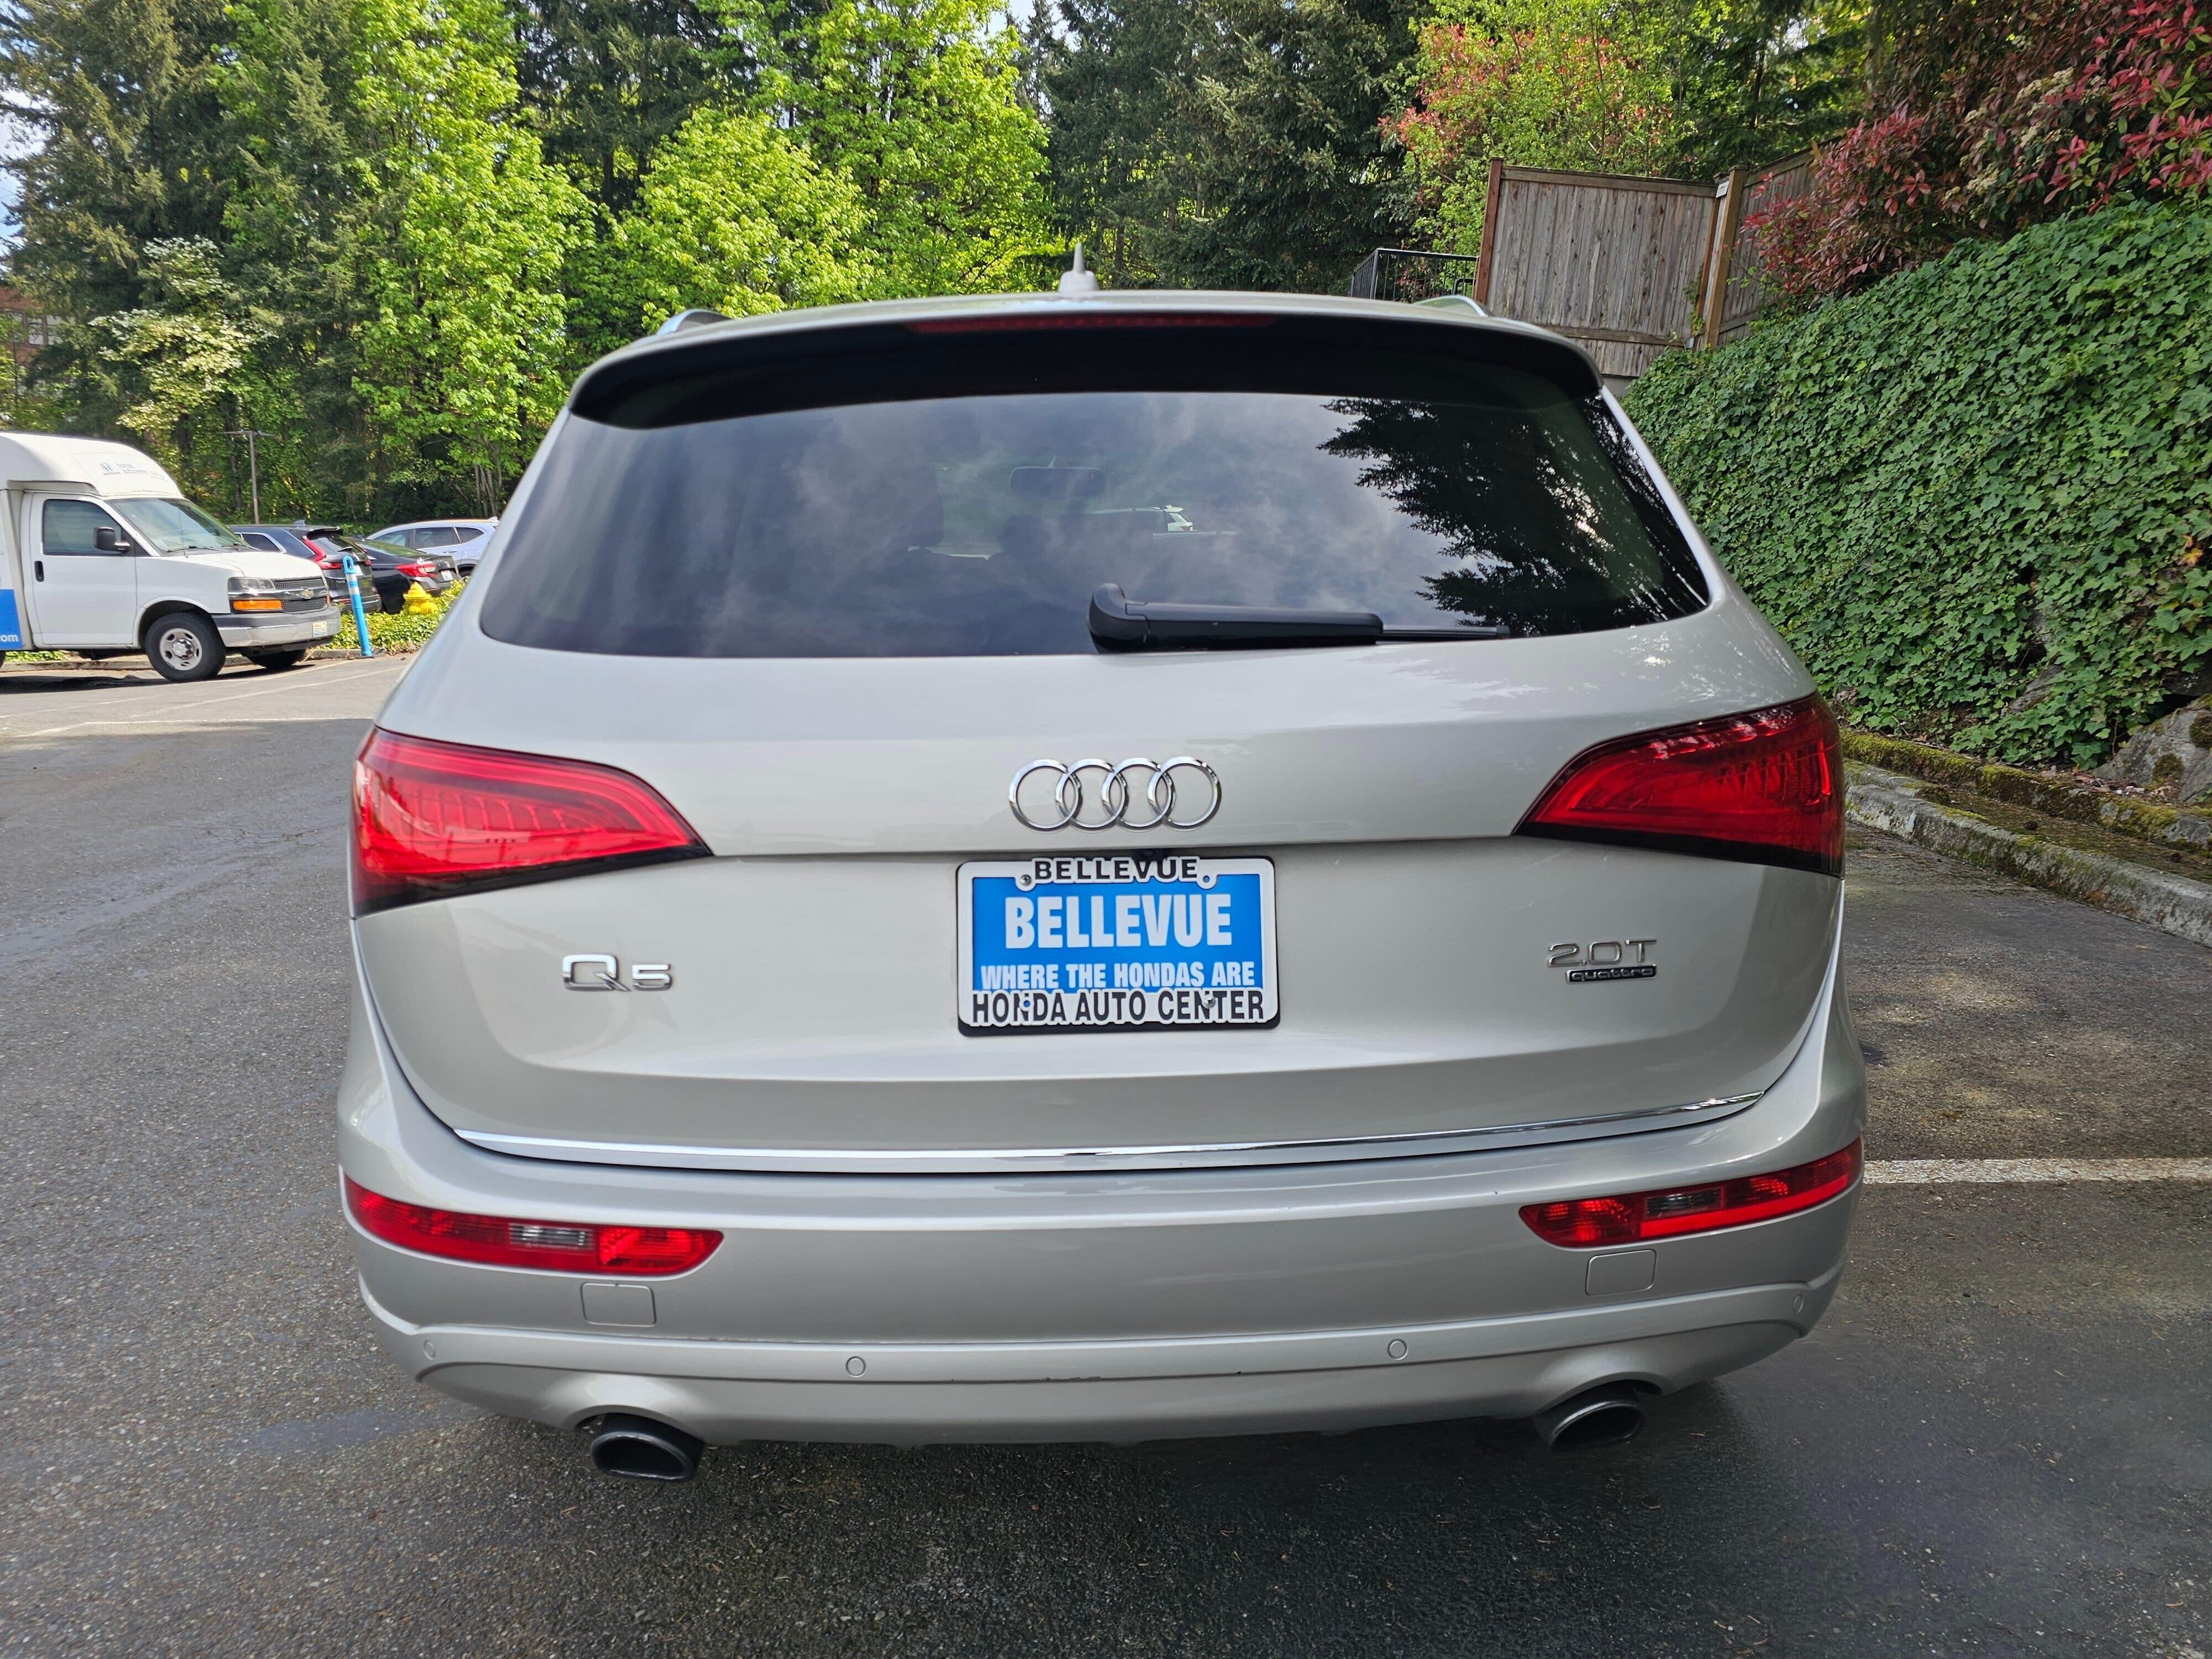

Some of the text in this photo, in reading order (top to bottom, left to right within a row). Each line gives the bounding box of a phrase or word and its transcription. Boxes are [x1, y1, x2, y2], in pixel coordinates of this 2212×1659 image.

[1034, 859, 1198, 880] BELLEVUE
[1005, 893, 1233, 949] BELLEVUE
[1547, 939, 1657, 968] 2.0T
[562, 954, 672, 992] Q5
[980, 961, 1255, 990] WHERE THE HONDAS ARE
[1571, 968, 1654, 982] quattro
[972, 990, 1264, 1023] HONDA AUTO CENTER
